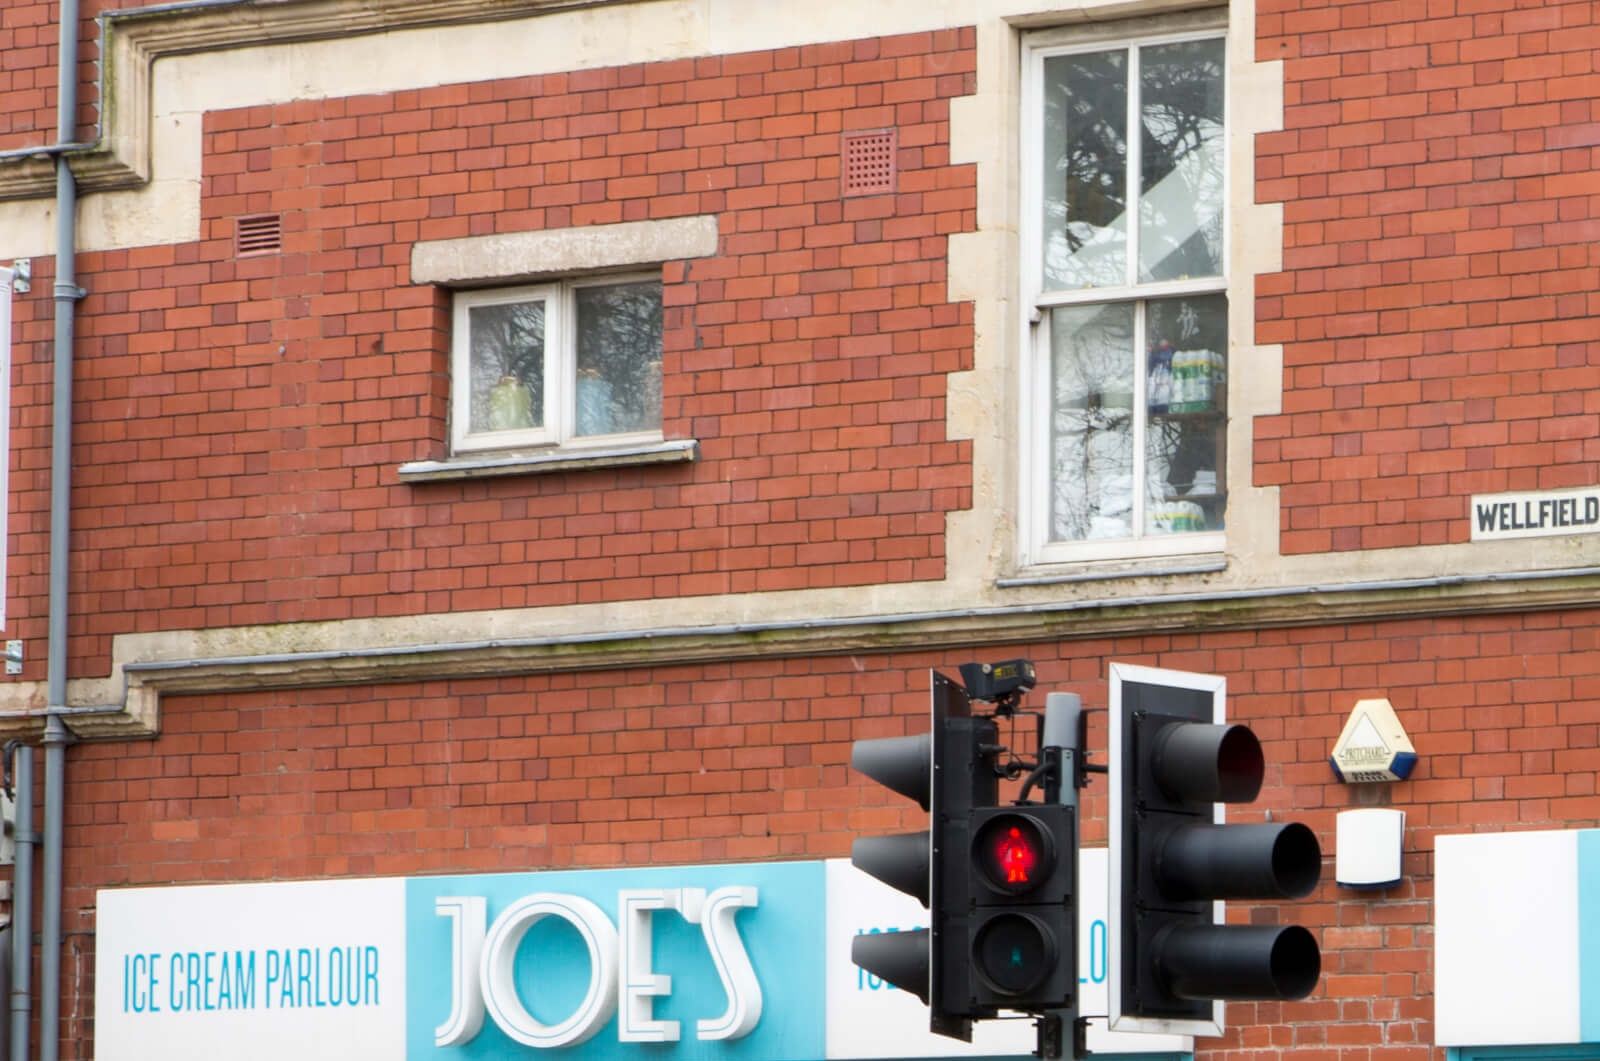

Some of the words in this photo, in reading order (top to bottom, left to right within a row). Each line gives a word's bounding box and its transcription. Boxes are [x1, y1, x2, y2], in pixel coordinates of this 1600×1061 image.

[1476, 497, 1600, 532] WELLFIELD
[123, 953, 162, 1013] ICE
[170, 950, 256, 1012] CREAM
[265, 945, 380, 1009] PARLOUR
[434, 885, 763, 1050] JOE'S
